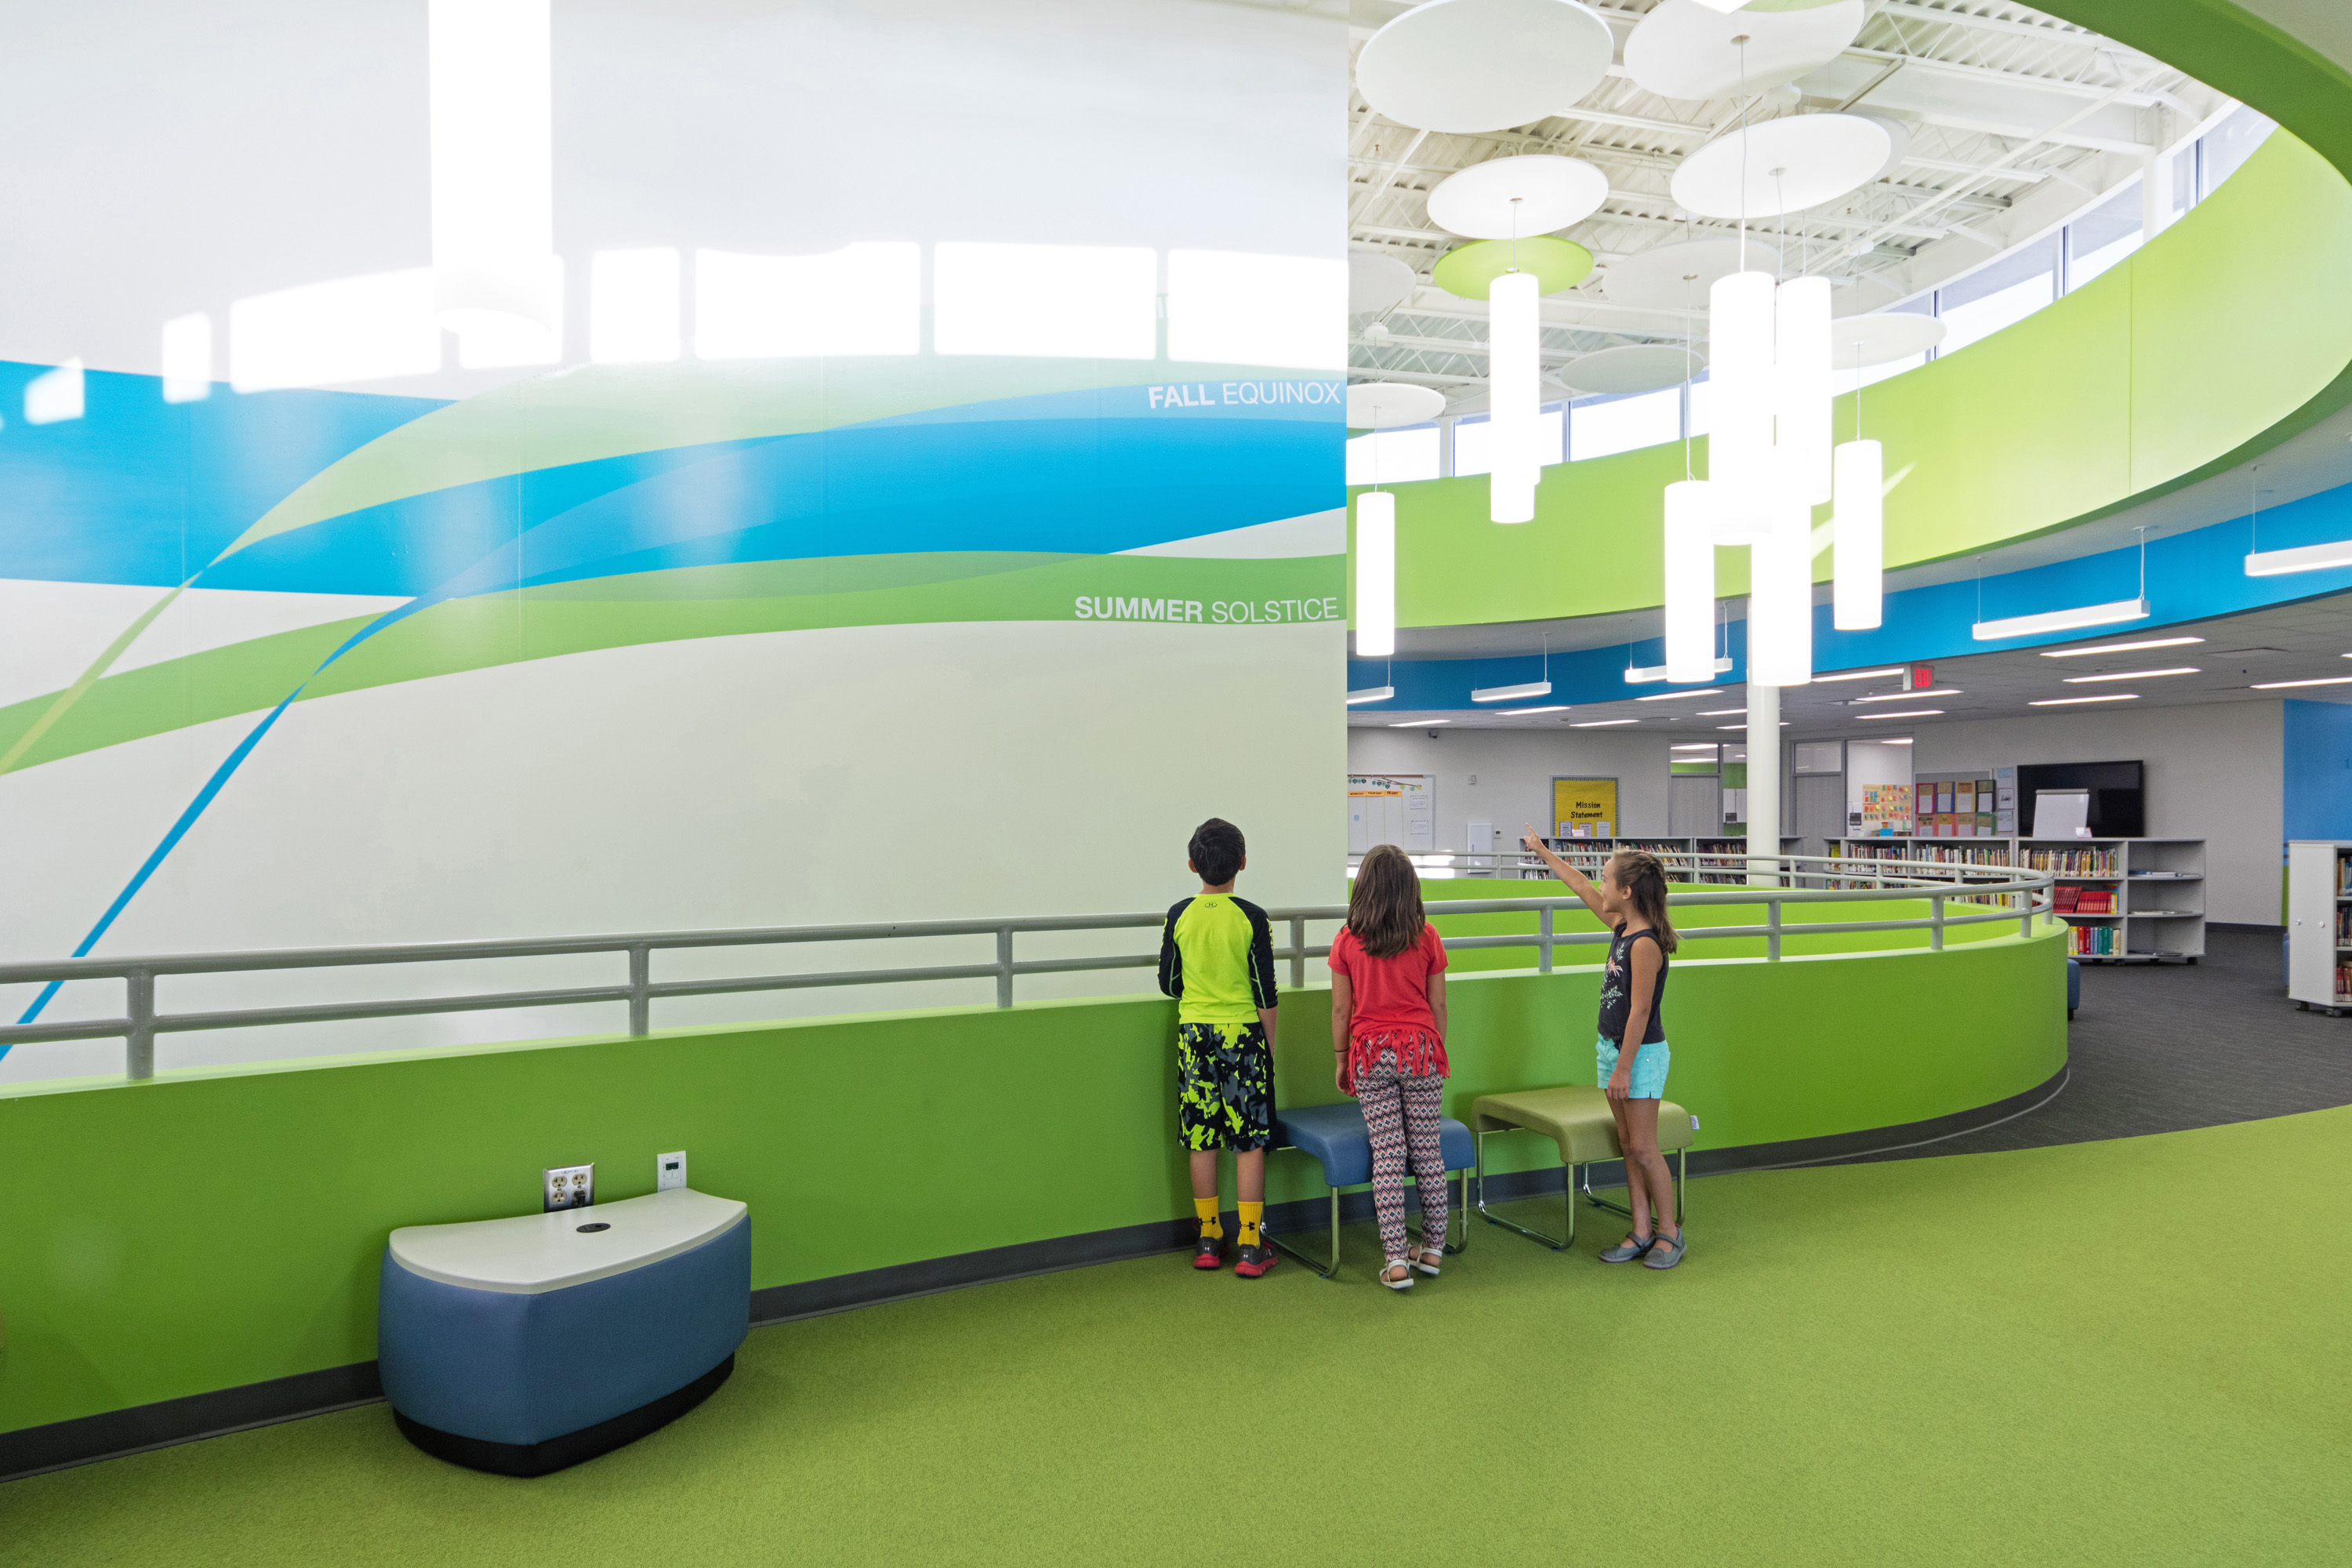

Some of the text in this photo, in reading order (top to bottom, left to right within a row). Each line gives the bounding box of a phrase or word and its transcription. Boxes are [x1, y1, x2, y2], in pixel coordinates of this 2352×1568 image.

[1149, 382, 1341, 408] FALL EQUINOX
[1074, 596, 1339, 623] SUMMER SOLSTICE
[1915, 669, 1931, 687] EXIT
